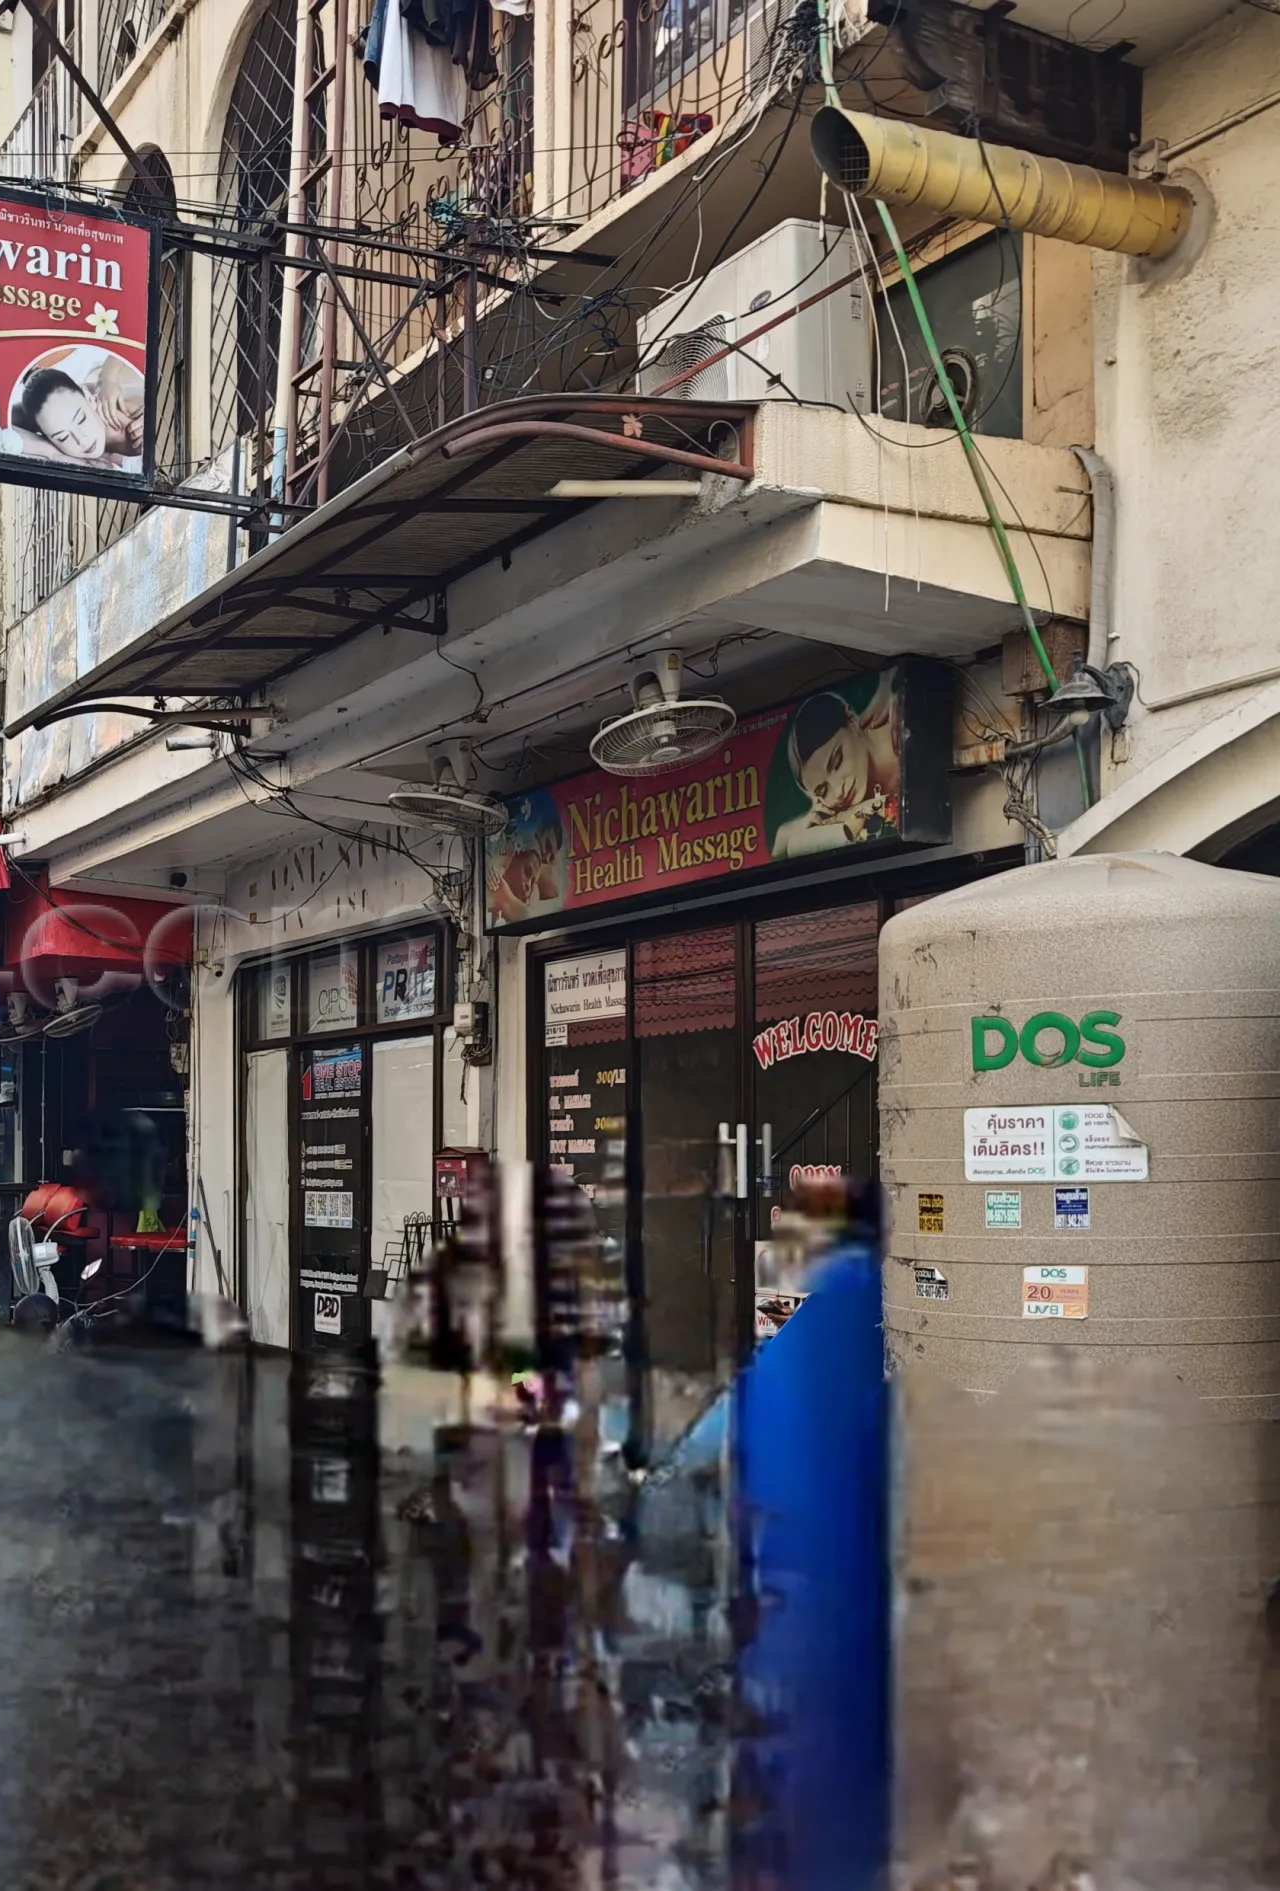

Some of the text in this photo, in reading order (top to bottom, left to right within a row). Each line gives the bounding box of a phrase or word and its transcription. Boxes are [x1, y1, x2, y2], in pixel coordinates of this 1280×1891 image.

[566, 748, 762, 860] Nichawarin
[573, 823, 760, 896] Health Massage
[582, 959, 626, 992] นวดเพื่อสุขภา
[583, 997, 602, 1011] Health
[605, 995, 626, 1010] Massag
[752, 1011, 879, 1070] WELCOME
[970, 1010, 1126, 1072] DOS
[314, 1059, 363, 1080] ONE STOP
[1077, 1071, 1122, 1088] LIFE
[987, 1113, 1045, 1135] คุ้มราคา
[972, 1138, 1045, 1157] เต็มลิตร!!
[1027, 1166, 1046, 1175] DOS
[1040, 1268, 1068, 1279] DOS
